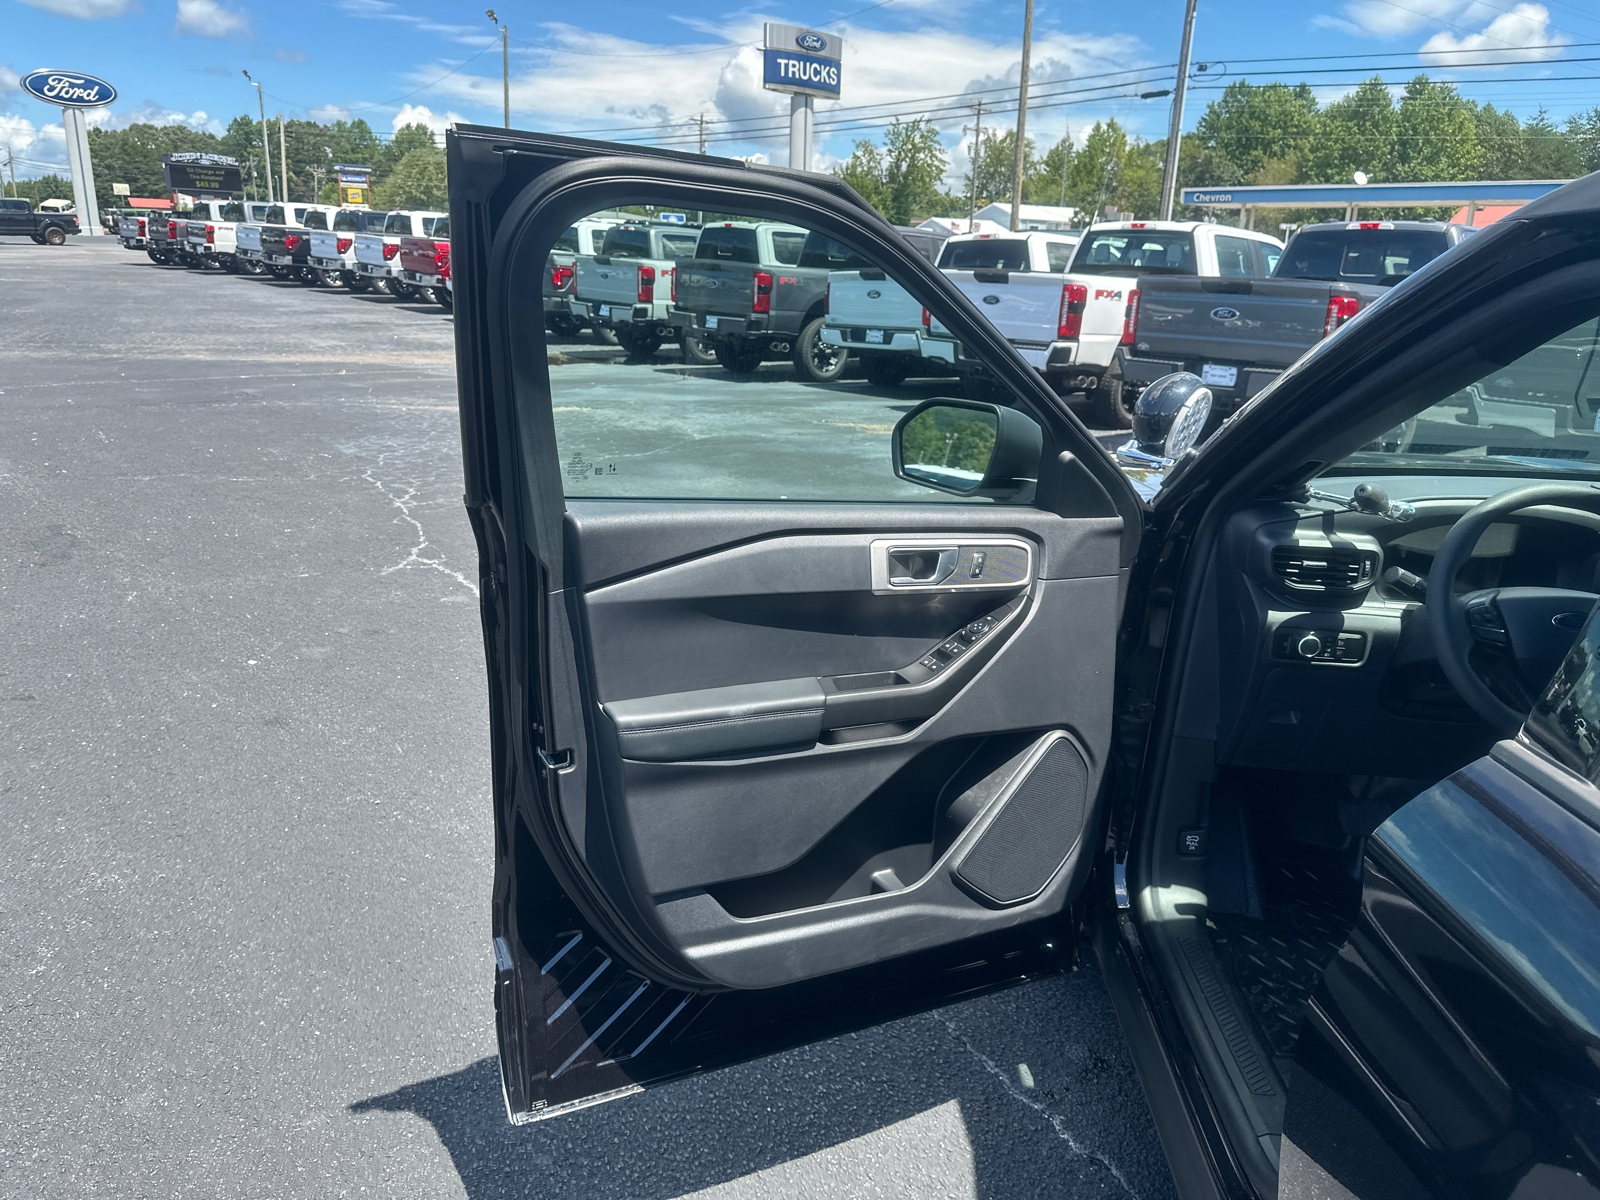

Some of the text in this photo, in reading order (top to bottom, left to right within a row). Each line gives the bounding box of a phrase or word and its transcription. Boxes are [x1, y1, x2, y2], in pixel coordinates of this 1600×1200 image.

[803, 35, 821, 49] Ford
[777, 58, 838, 86] TRUCKS
[43, 75, 100, 102] Ford
[195, 180, 219, 188] $49.99
[1193, 192, 1232, 202] Chevron
[1095, 289, 1122, 301] FX4
